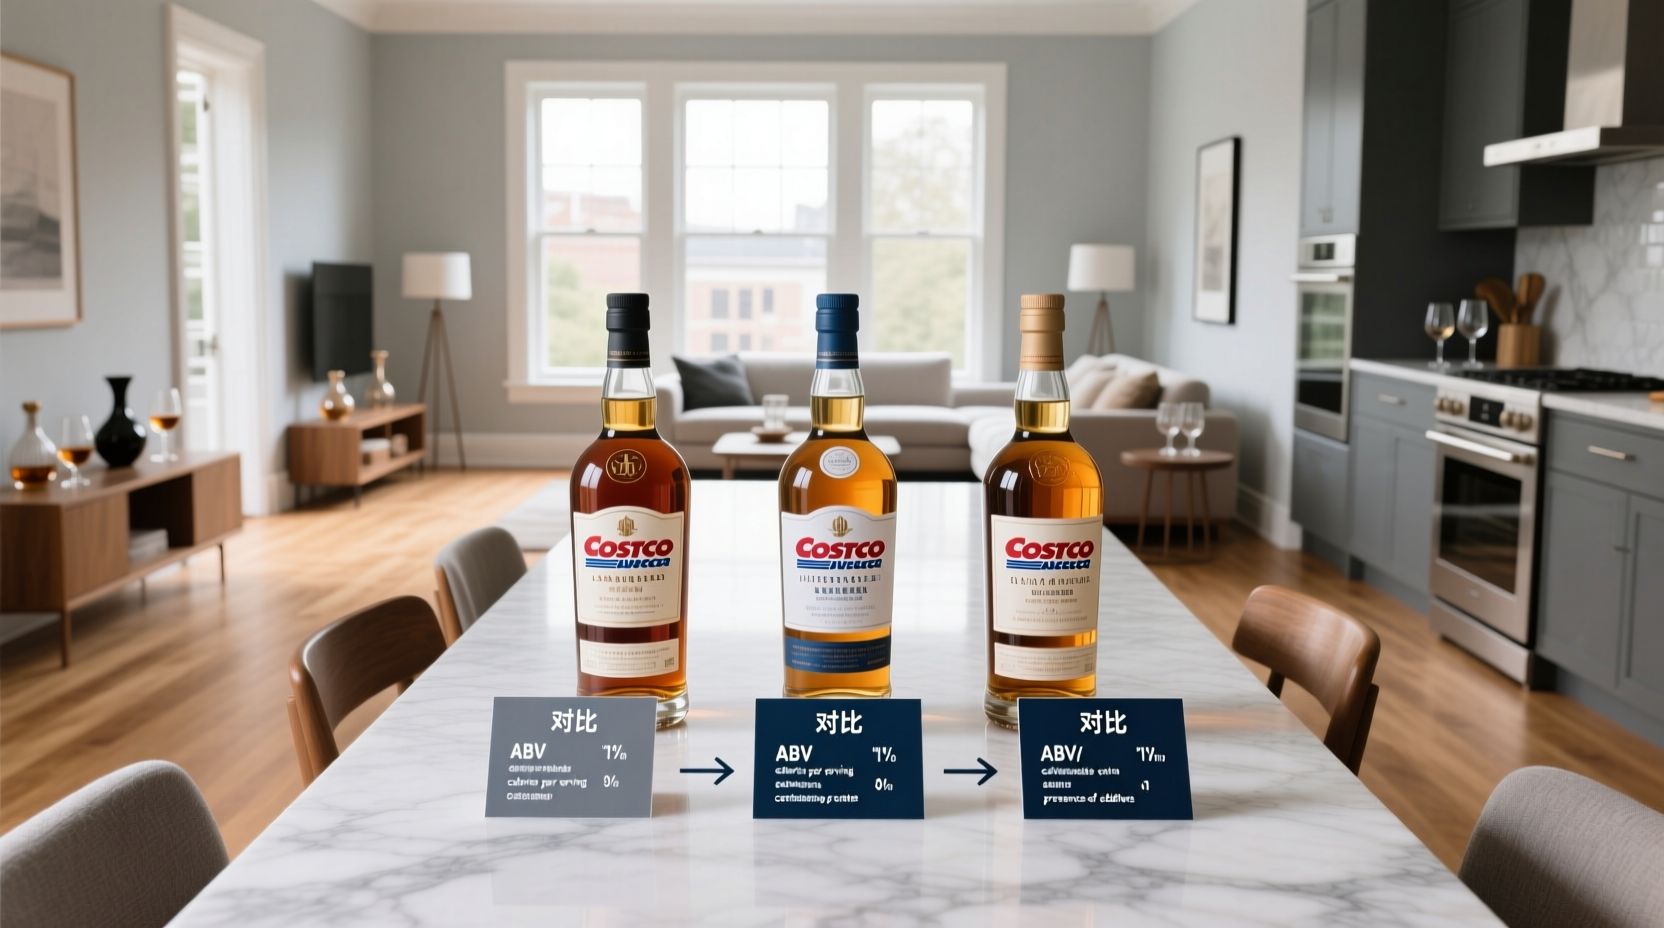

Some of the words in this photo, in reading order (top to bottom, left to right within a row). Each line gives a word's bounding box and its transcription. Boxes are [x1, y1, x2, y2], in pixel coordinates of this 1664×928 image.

[584, 535, 674, 558] COSTCO
[795, 537, 886, 559] COSTCO
[1005, 537, 1094, 559] COSTCO
[551, 708, 598, 733] 对比
[816, 709, 863, 735] 对比
[1080, 709, 1127, 734] 对比
[510, 742, 547, 760] ABV
[775, 744, 813, 762] ABV
